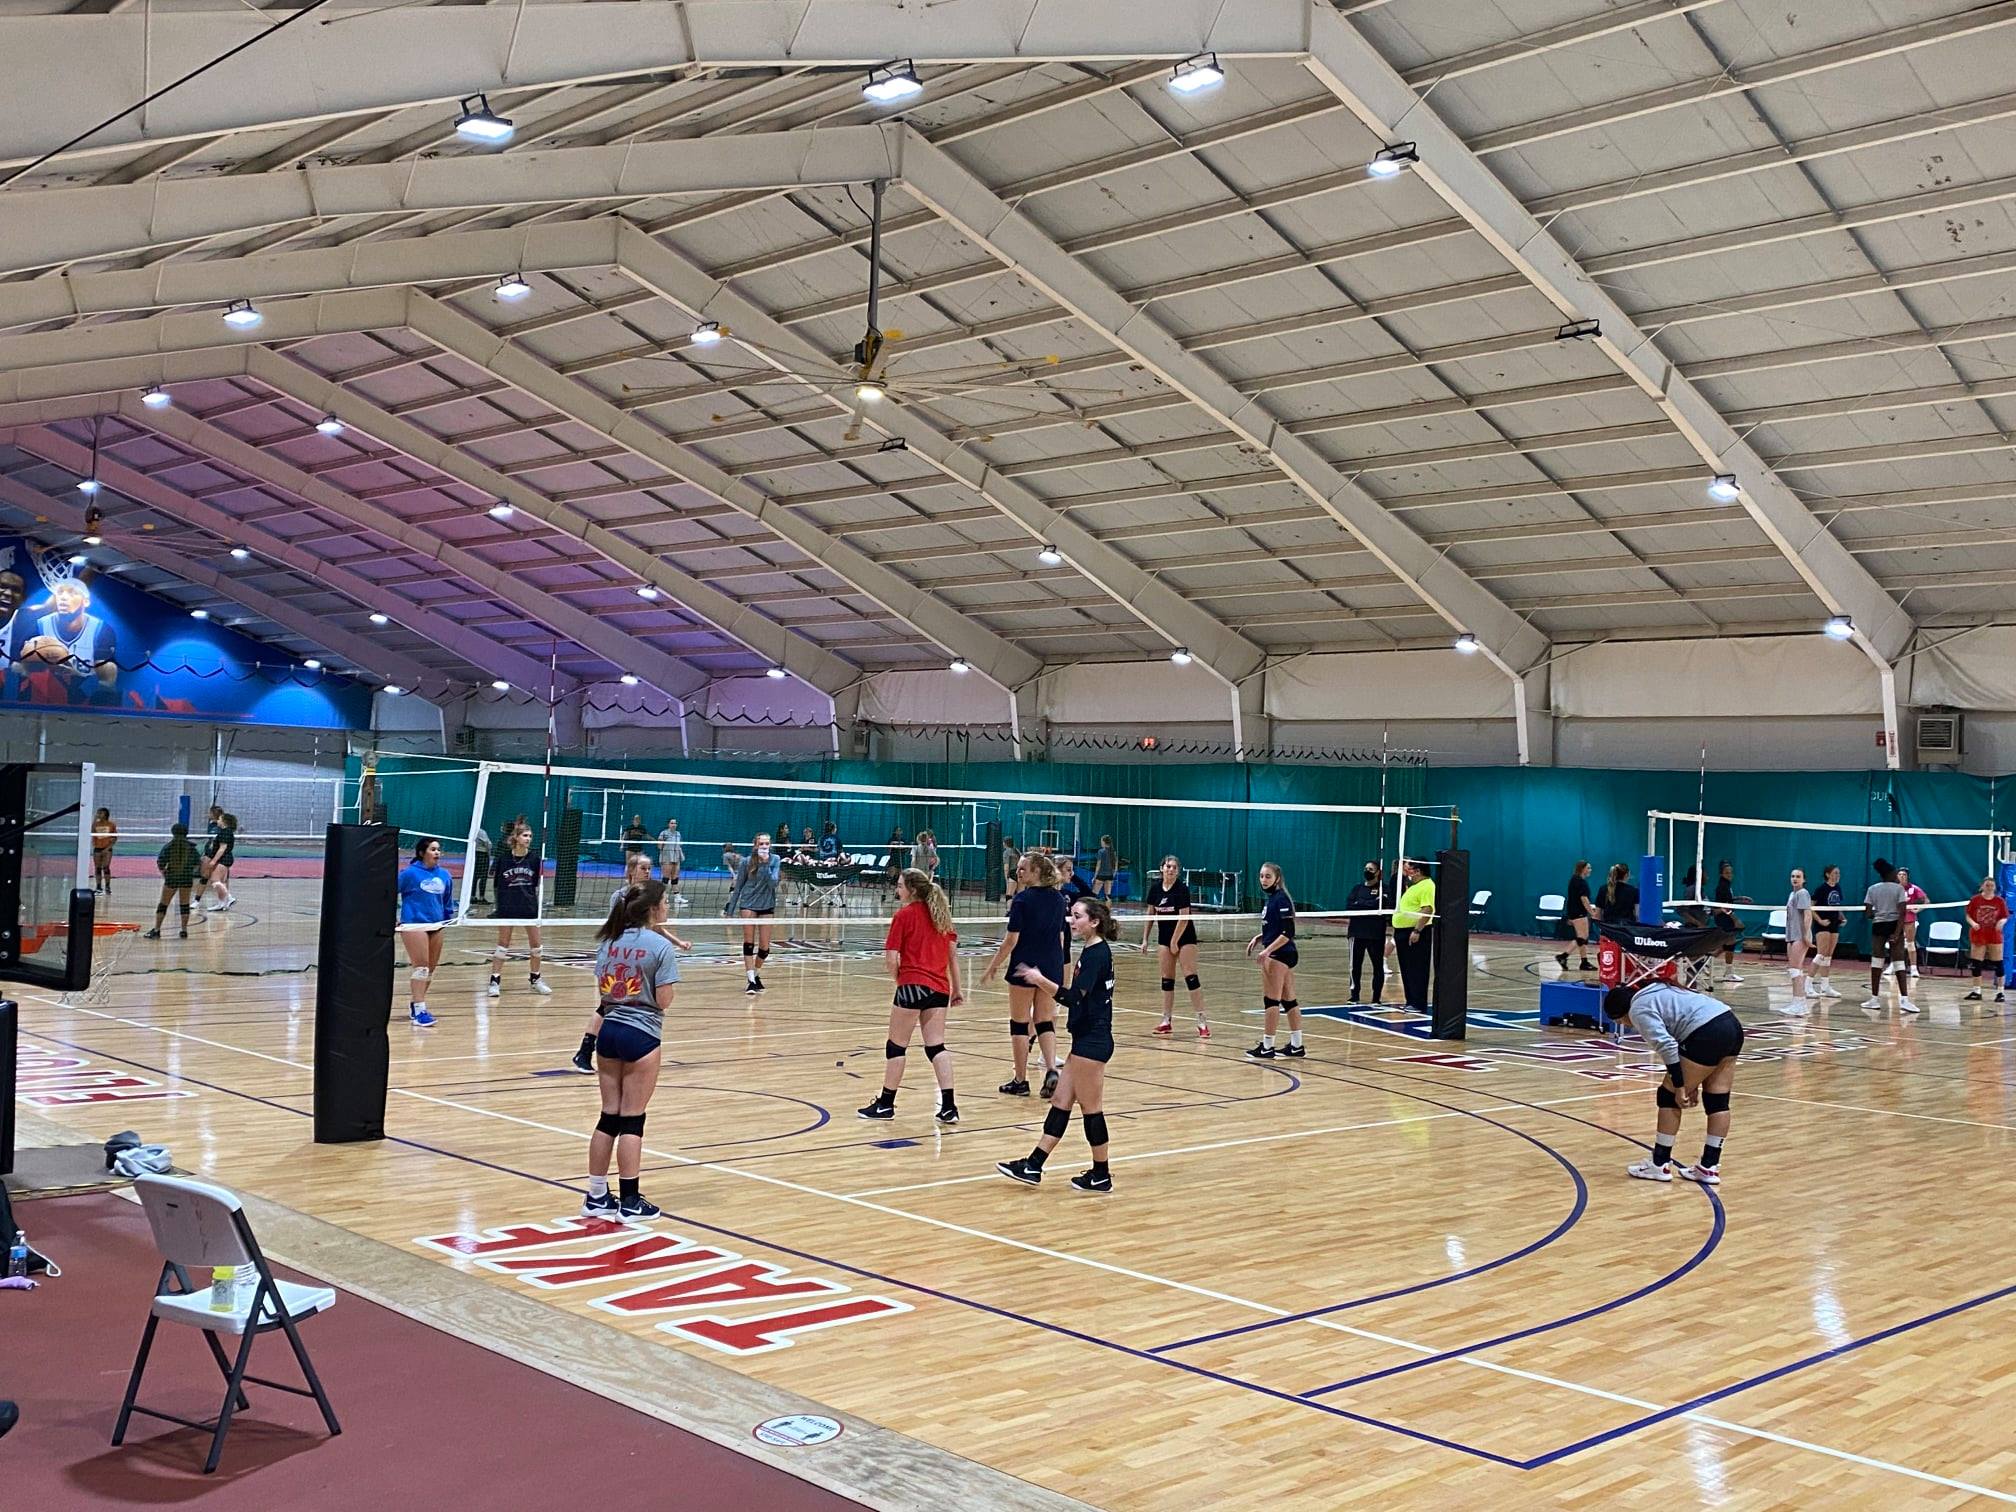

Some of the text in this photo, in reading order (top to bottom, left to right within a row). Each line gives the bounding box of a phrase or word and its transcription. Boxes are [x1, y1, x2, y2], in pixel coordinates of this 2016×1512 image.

[1634, 936, 1668, 948] Wilson
[607, 945, 648, 961] MVP
[896, 983, 935, 1008] NIK
[800, 1416, 837, 1432] WELCOME
